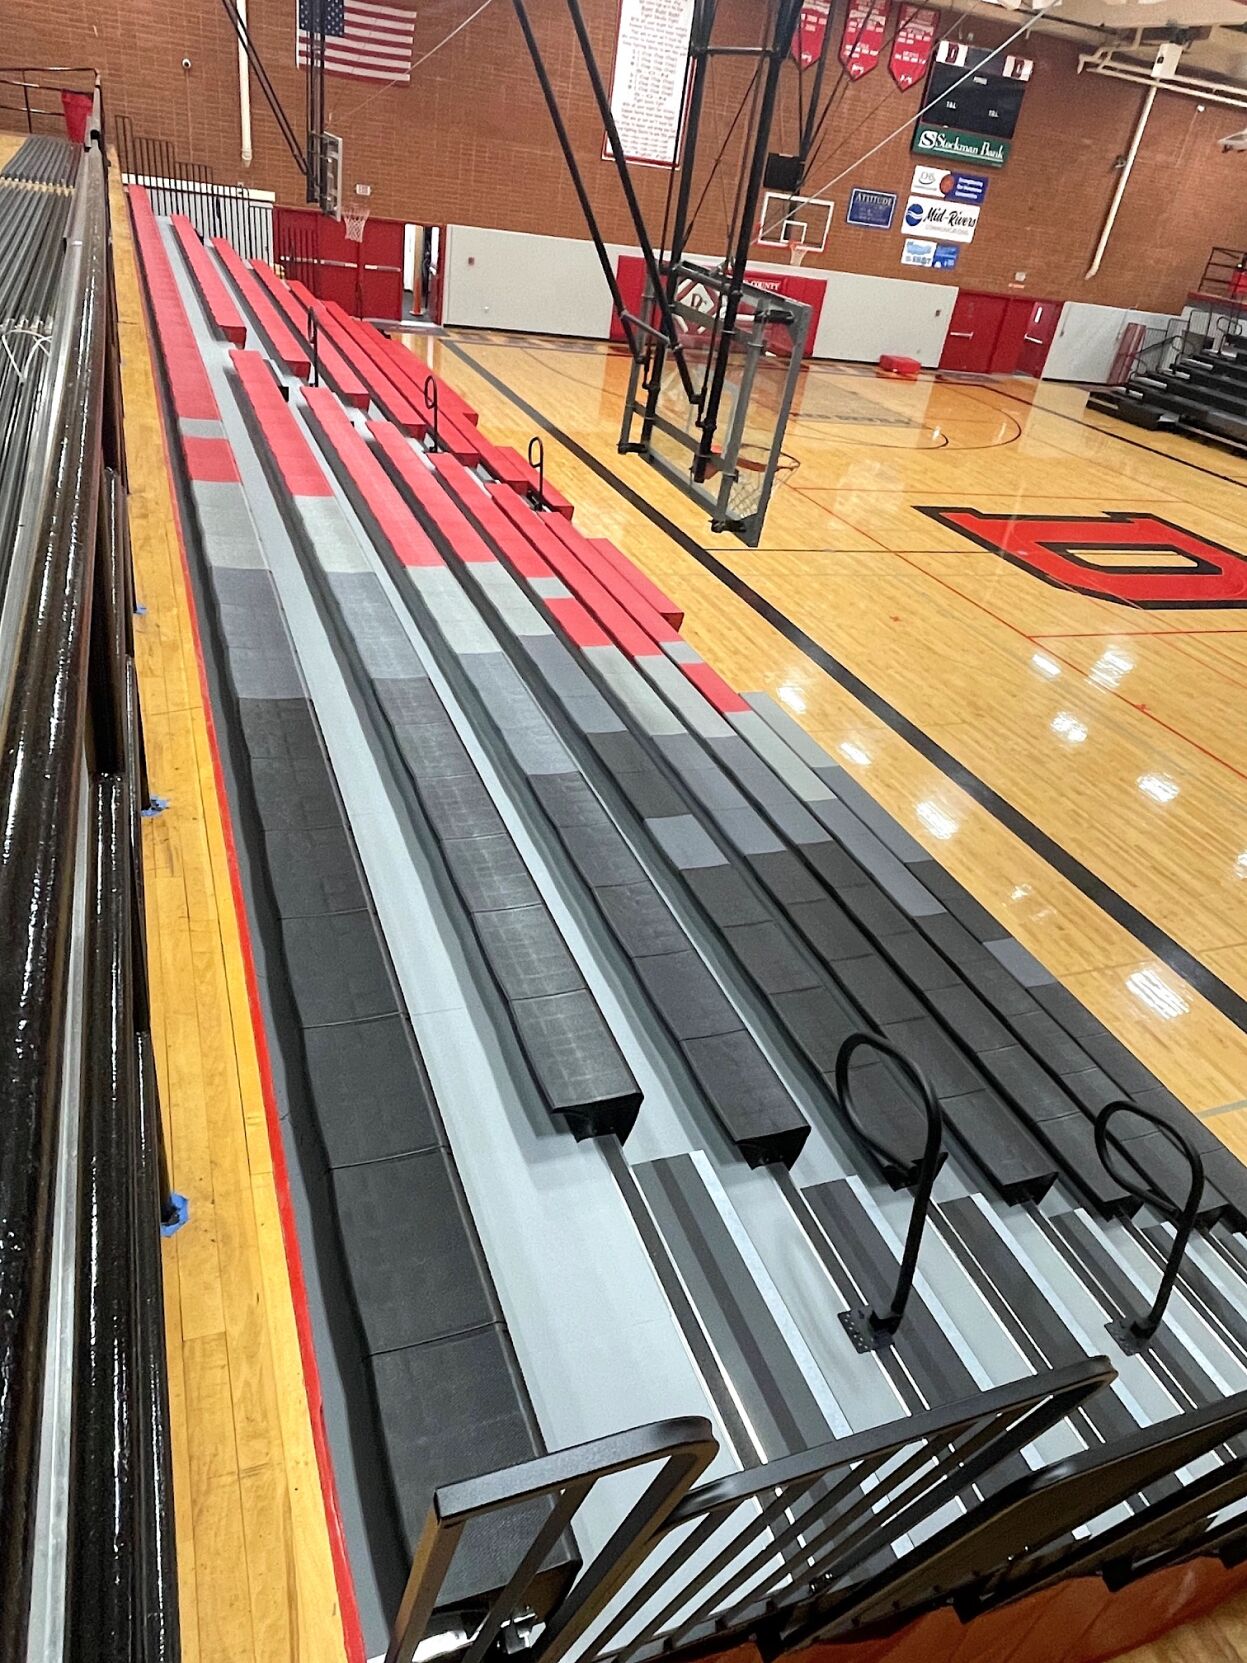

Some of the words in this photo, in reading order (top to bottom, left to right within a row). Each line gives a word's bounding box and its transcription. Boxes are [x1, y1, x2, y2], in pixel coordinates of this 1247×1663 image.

[936, 133, 978, 155] Stockman
[980, 141, 1004, 159] Bank
[855, 193, 893, 206] ATTITUDE
[923, 207, 977, 228] Mid-Rivers
[750, 280, 781, 291] COUNTY
